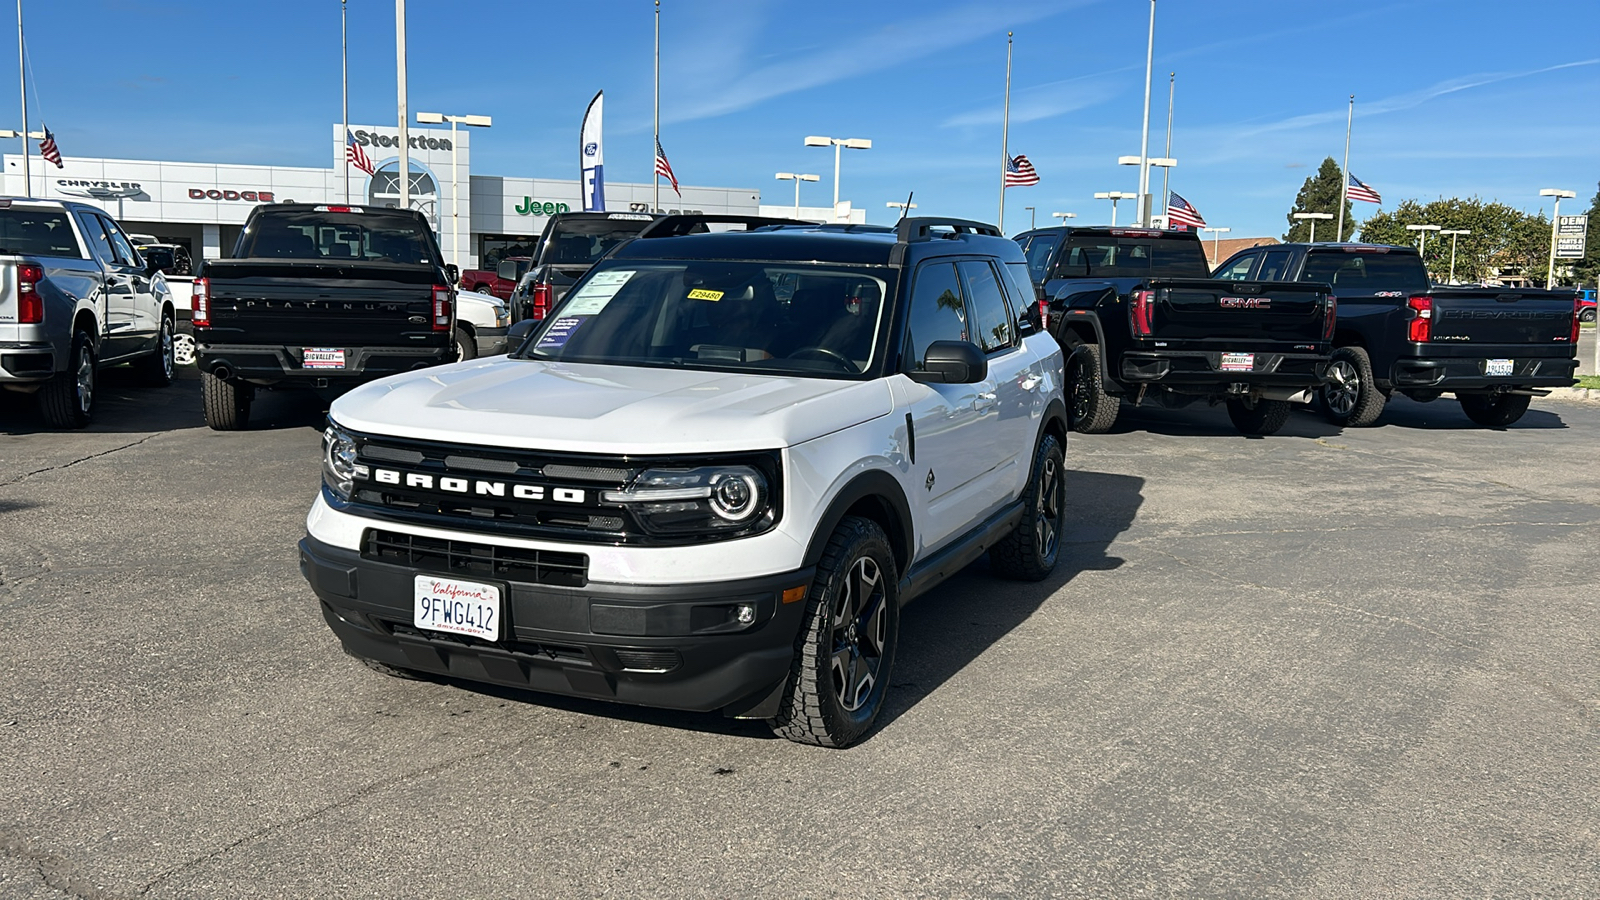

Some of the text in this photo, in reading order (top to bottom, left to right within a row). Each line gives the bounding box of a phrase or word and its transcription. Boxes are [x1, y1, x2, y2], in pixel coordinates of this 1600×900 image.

[354, 129, 453, 151] Stockton
[56, 179, 142, 189] CHRYSLER
[188, 188, 275, 202] DODGE
[1560, 217, 1585, 225] OEM
[246, 301, 398, 310] PLATINUM
[1220, 297, 1271, 309] GMC
[1444, 309, 1568, 320] CHEVROLET
[375, 468, 586, 503] BRONCO
[433, 581, 487, 601] California
[421, 597, 494, 632] 9FWG412
[436, 623, 481, 634] dmv.ca.gov
